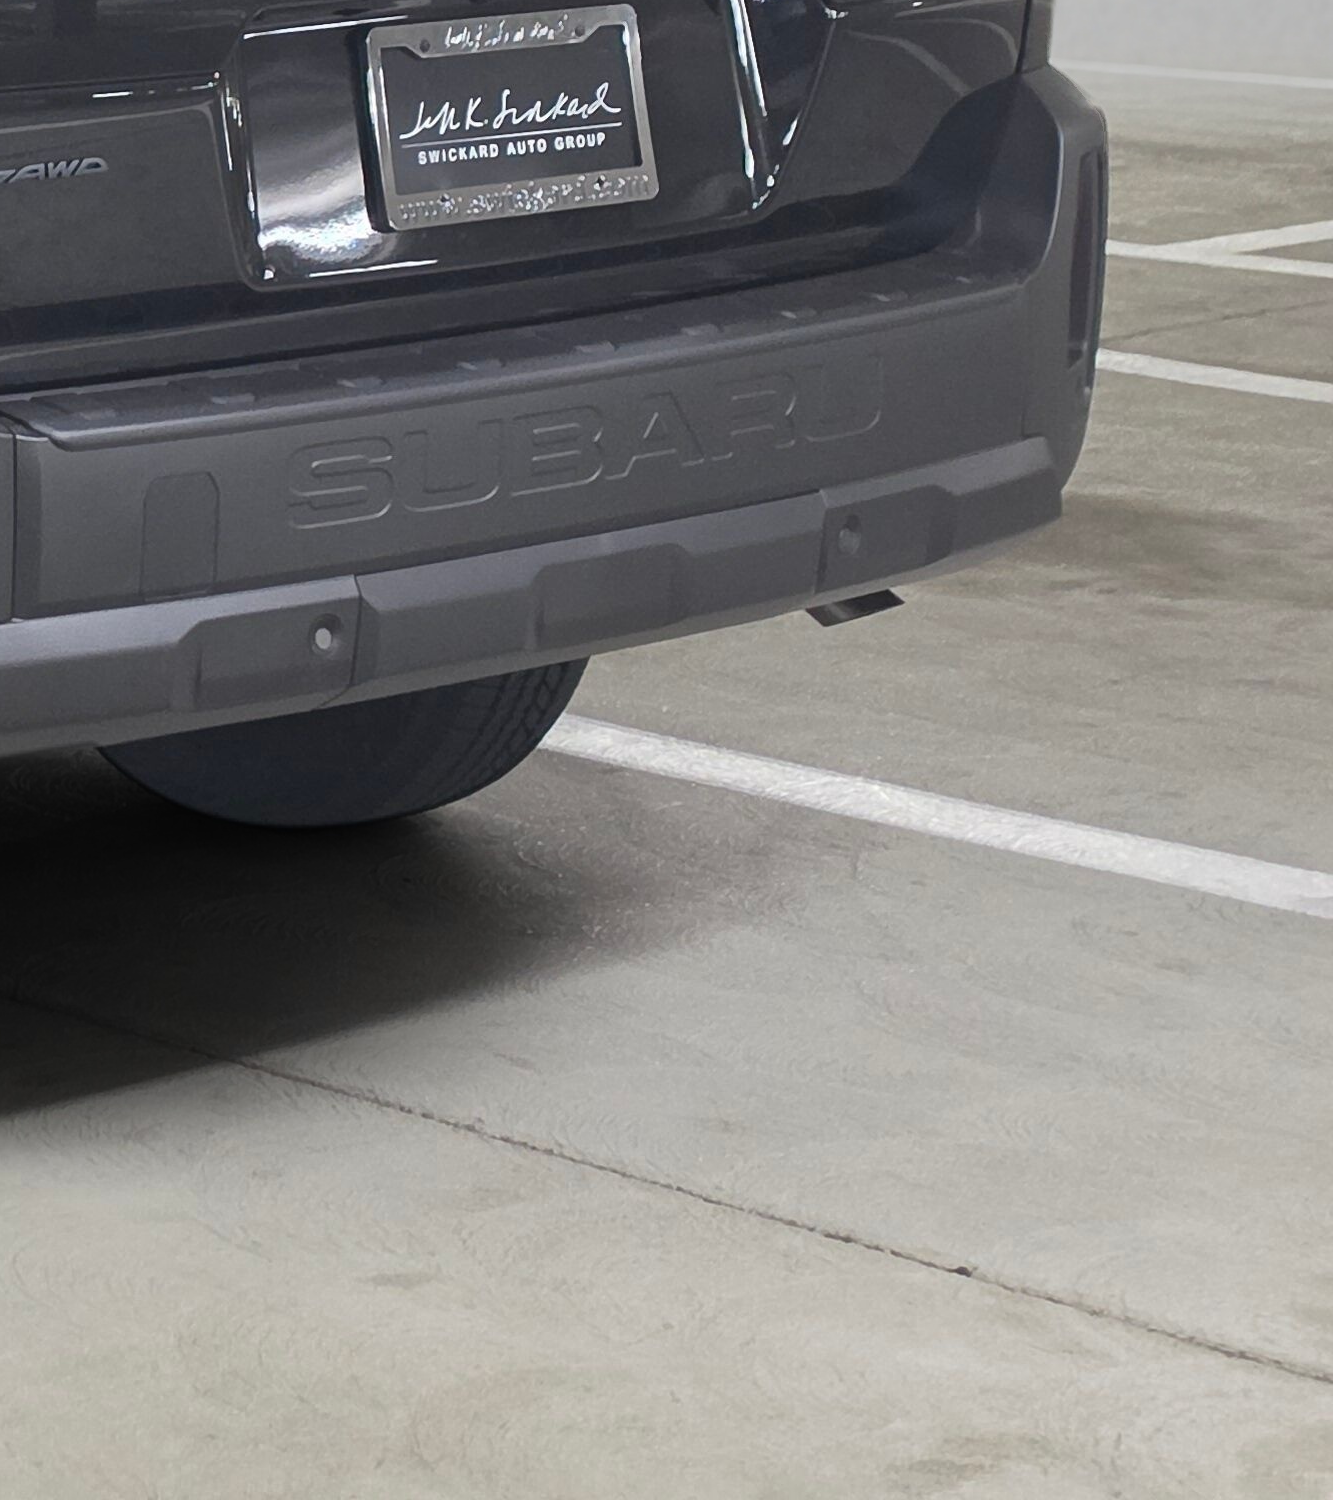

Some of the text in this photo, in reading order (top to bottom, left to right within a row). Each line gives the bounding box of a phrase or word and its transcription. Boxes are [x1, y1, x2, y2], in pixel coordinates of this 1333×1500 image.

[418, 132, 607, 165] SWICKARD AUTO GROUP
[8, 157, 109, 184] AWD
[287, 357, 884, 529] SUBARU
